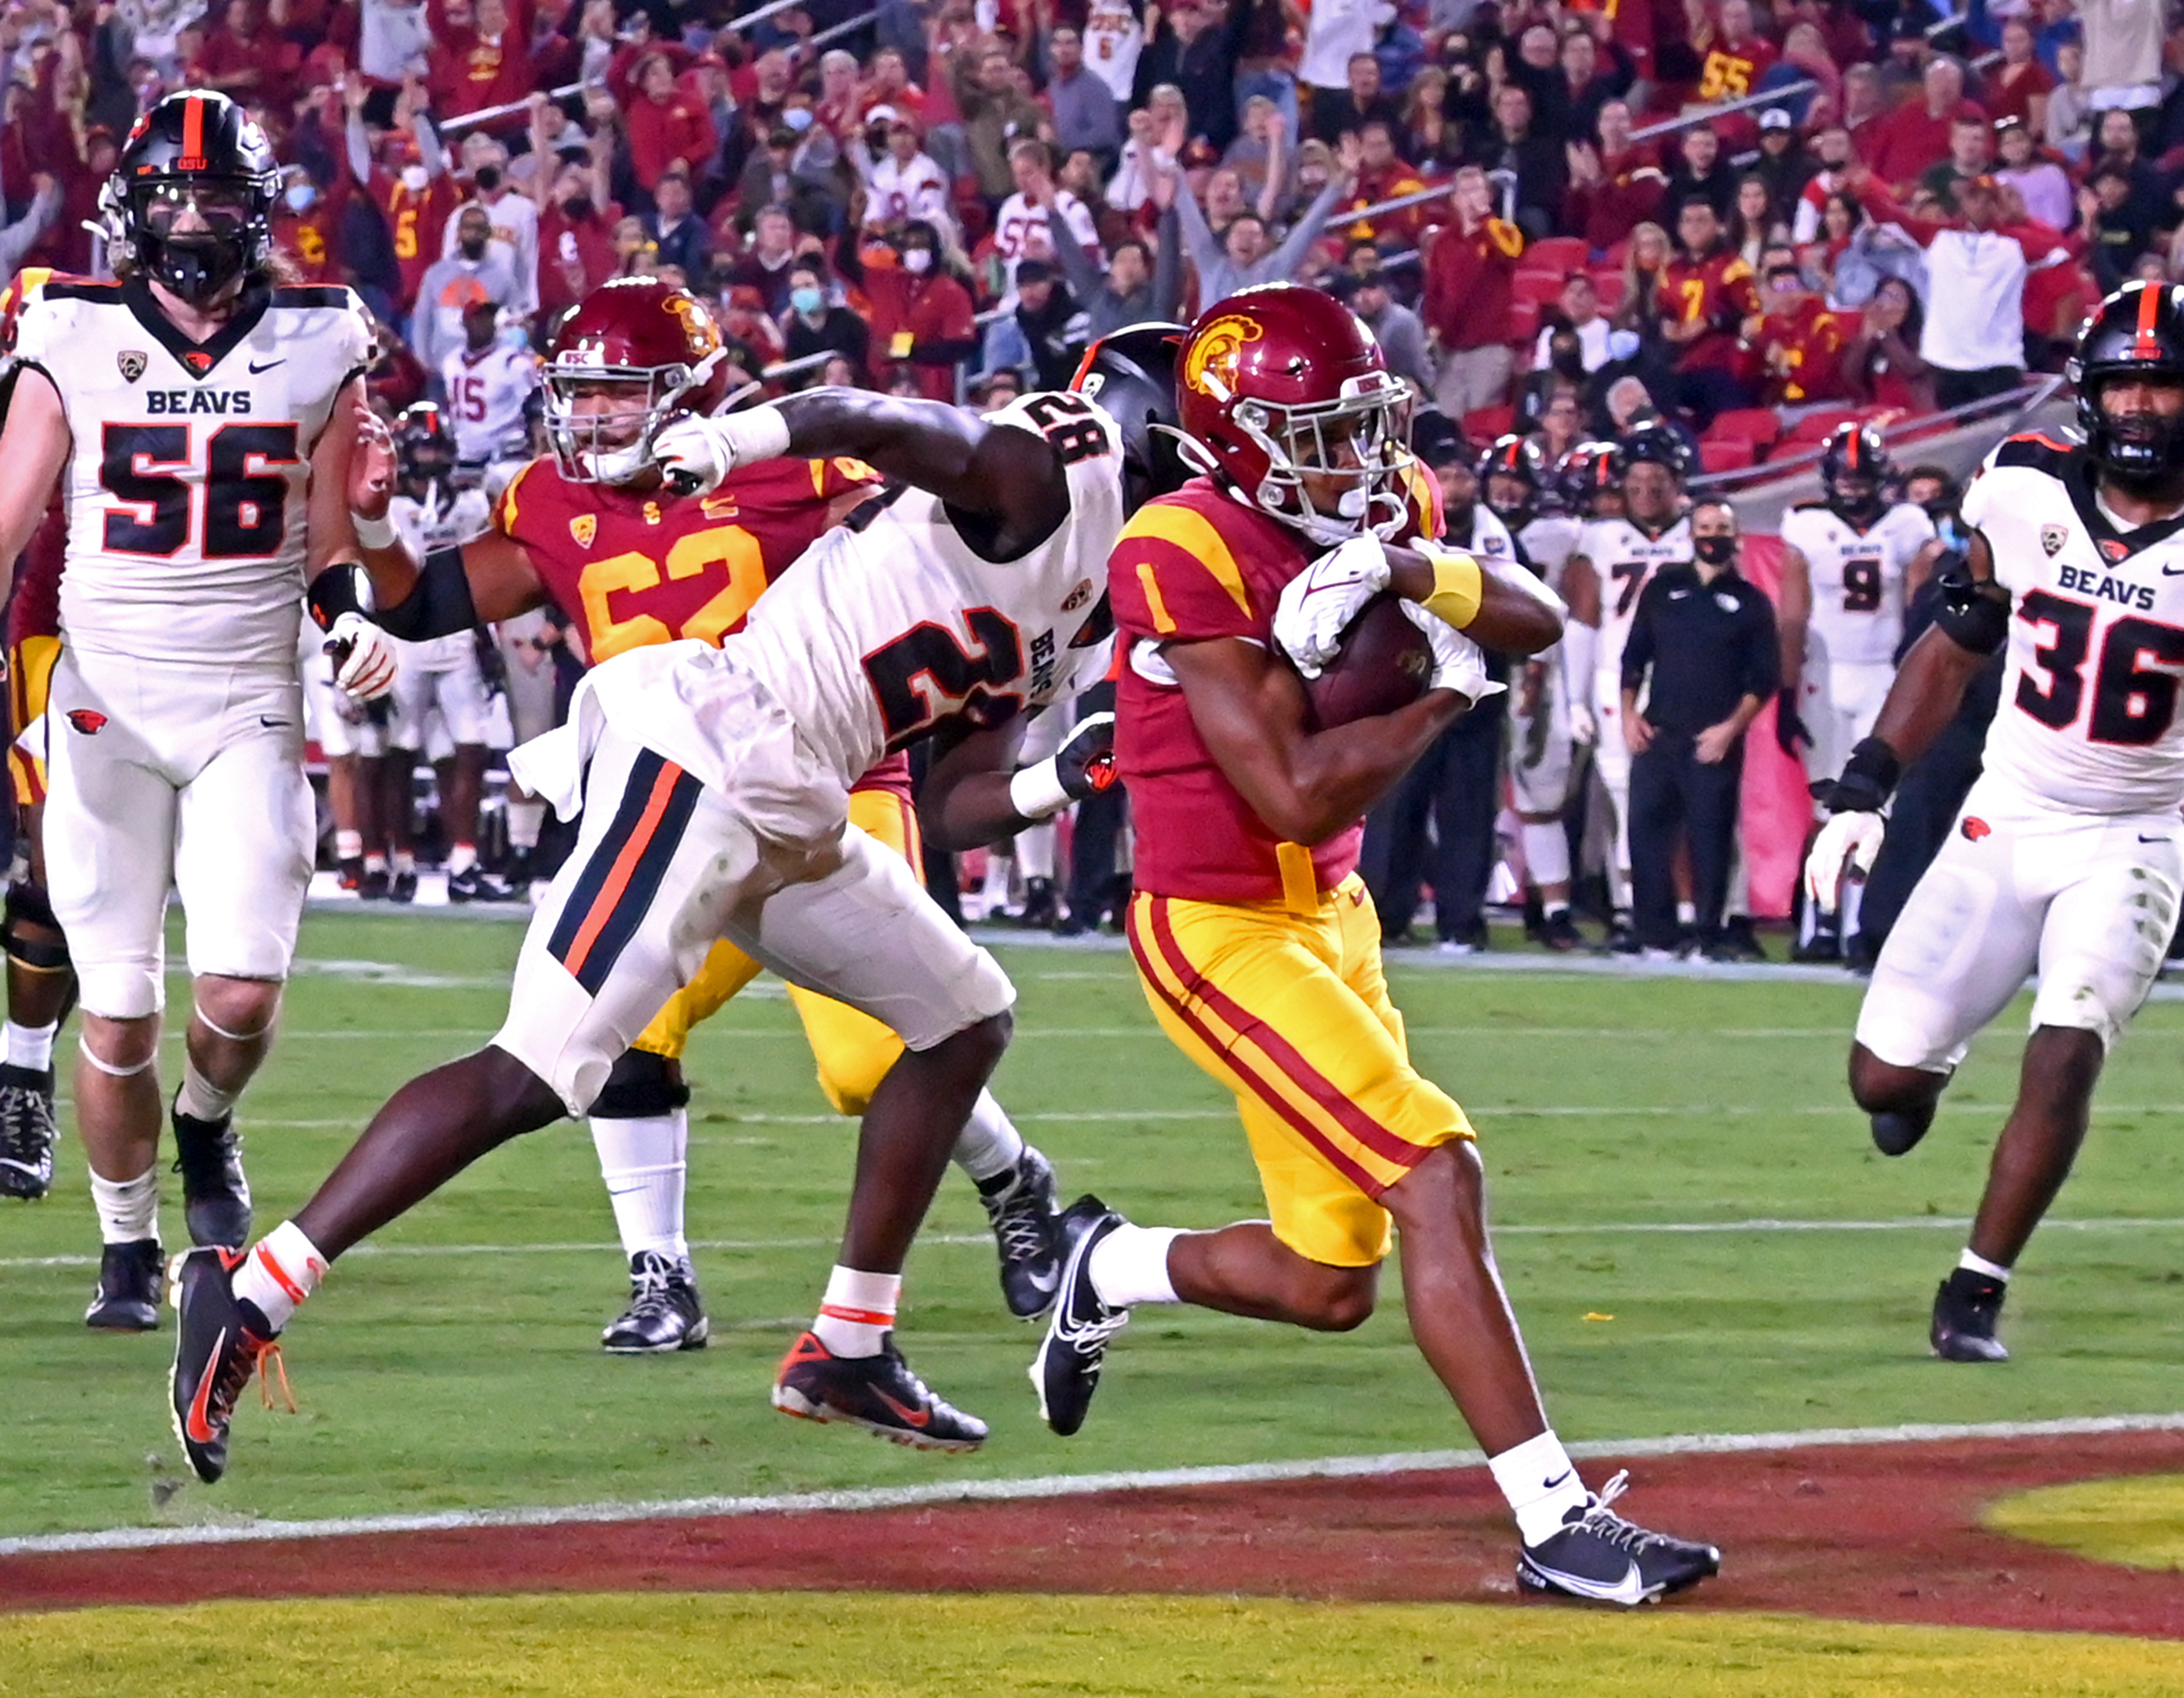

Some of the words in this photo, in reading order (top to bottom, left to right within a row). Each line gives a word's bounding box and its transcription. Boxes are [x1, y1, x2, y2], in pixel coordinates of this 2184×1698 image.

[1700, 51, 1754, 99] 55
[177, 157, 208, 170] OSU
[395, 210, 417, 258] 5
[1681, 280, 1704, 320] 7
[565, 353, 589, 364] USC
[147, 391, 251, 414] BEAVS
[453, 376, 487, 422] 15
[1021, 394, 1111, 465] 28
[99, 421, 299, 559] 56
[578, 525, 767, 667] 62
[1136, 563, 1176, 633] 1
[1843, 559, 1882, 612] 9
[2058, 565, 2156, 610] BEAVS
[2015, 586, 2184, 746] 36
